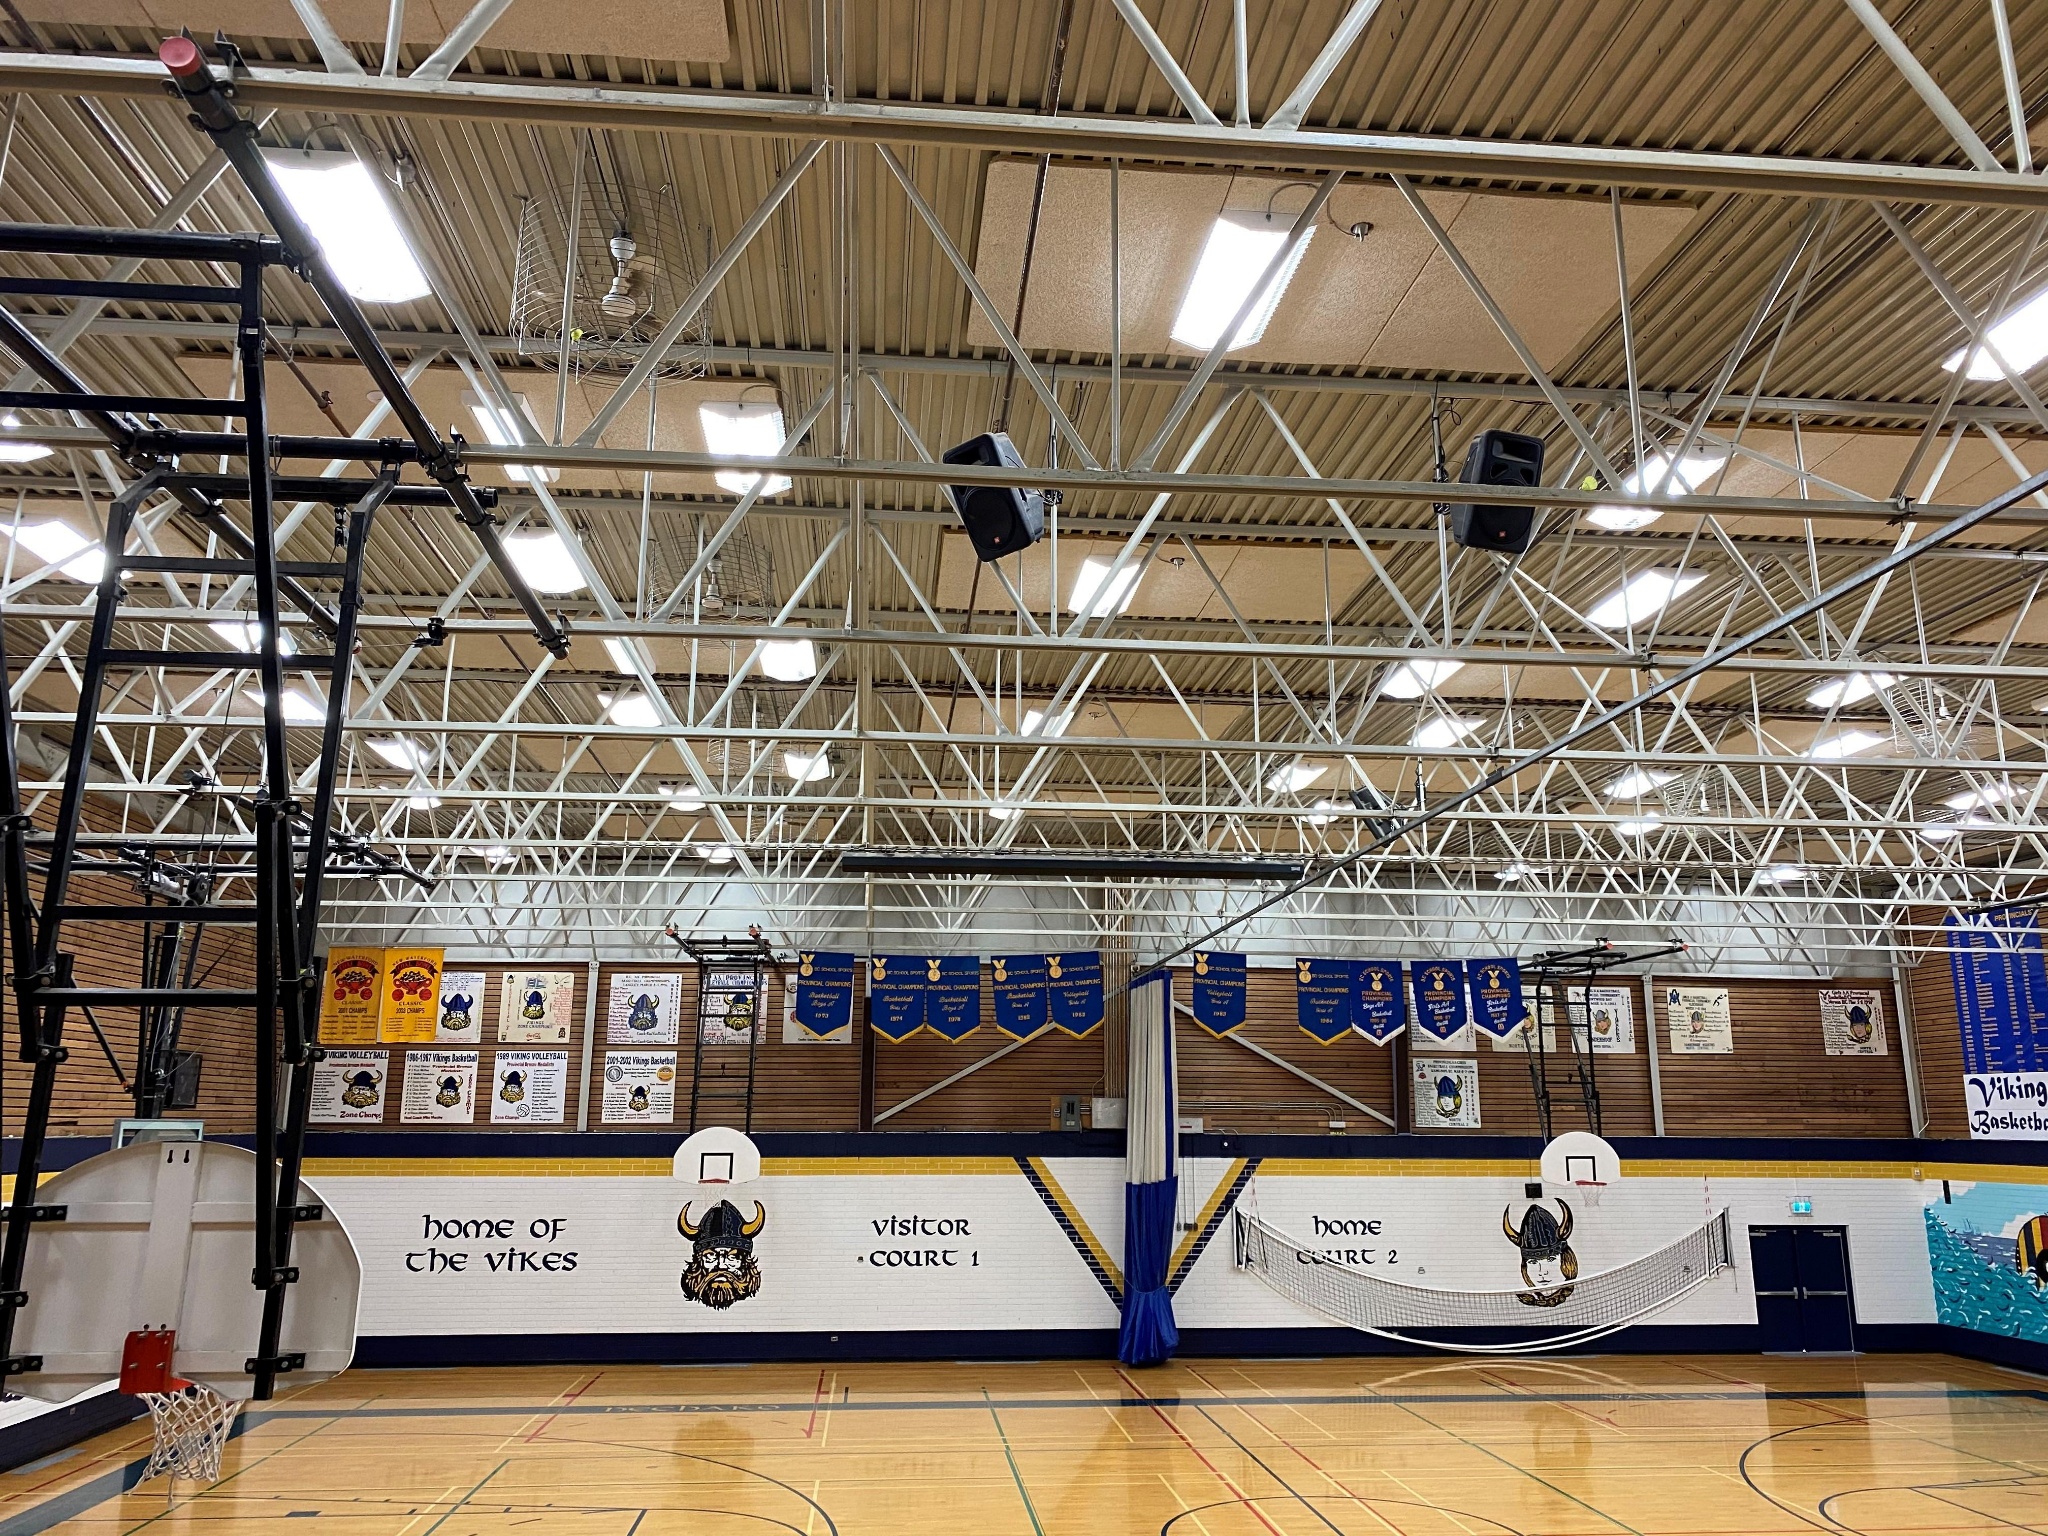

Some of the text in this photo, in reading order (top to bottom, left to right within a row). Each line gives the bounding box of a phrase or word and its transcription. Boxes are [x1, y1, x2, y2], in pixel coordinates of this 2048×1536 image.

[1995, 909, 2032, 921] PROINCIALS
[1075, 978, 1101, 986] CHAMPIONS
[1219, 980, 1245, 988] CHAMPIONS
[328, 1051, 348, 1059] VIKING
[349, 1051, 388, 1060] VOLLEYBALL
[432, 1053, 451, 1064] Vikings
[451, 1053, 478, 1062] Basketball
[510, 1052, 530, 1060] VIKING
[532, 1052, 567, 1060] VOLLEYBALL
[632, 1056, 650, 1067] Vikings
[650, 1056, 675, 1065] Basketball
[1969, 1075, 2047, 1108] Viking
[530, 1218, 567, 1243] OF
[869, 1249, 980, 1267] COURT 1
[1388, 1249, 1398, 1264] 2
